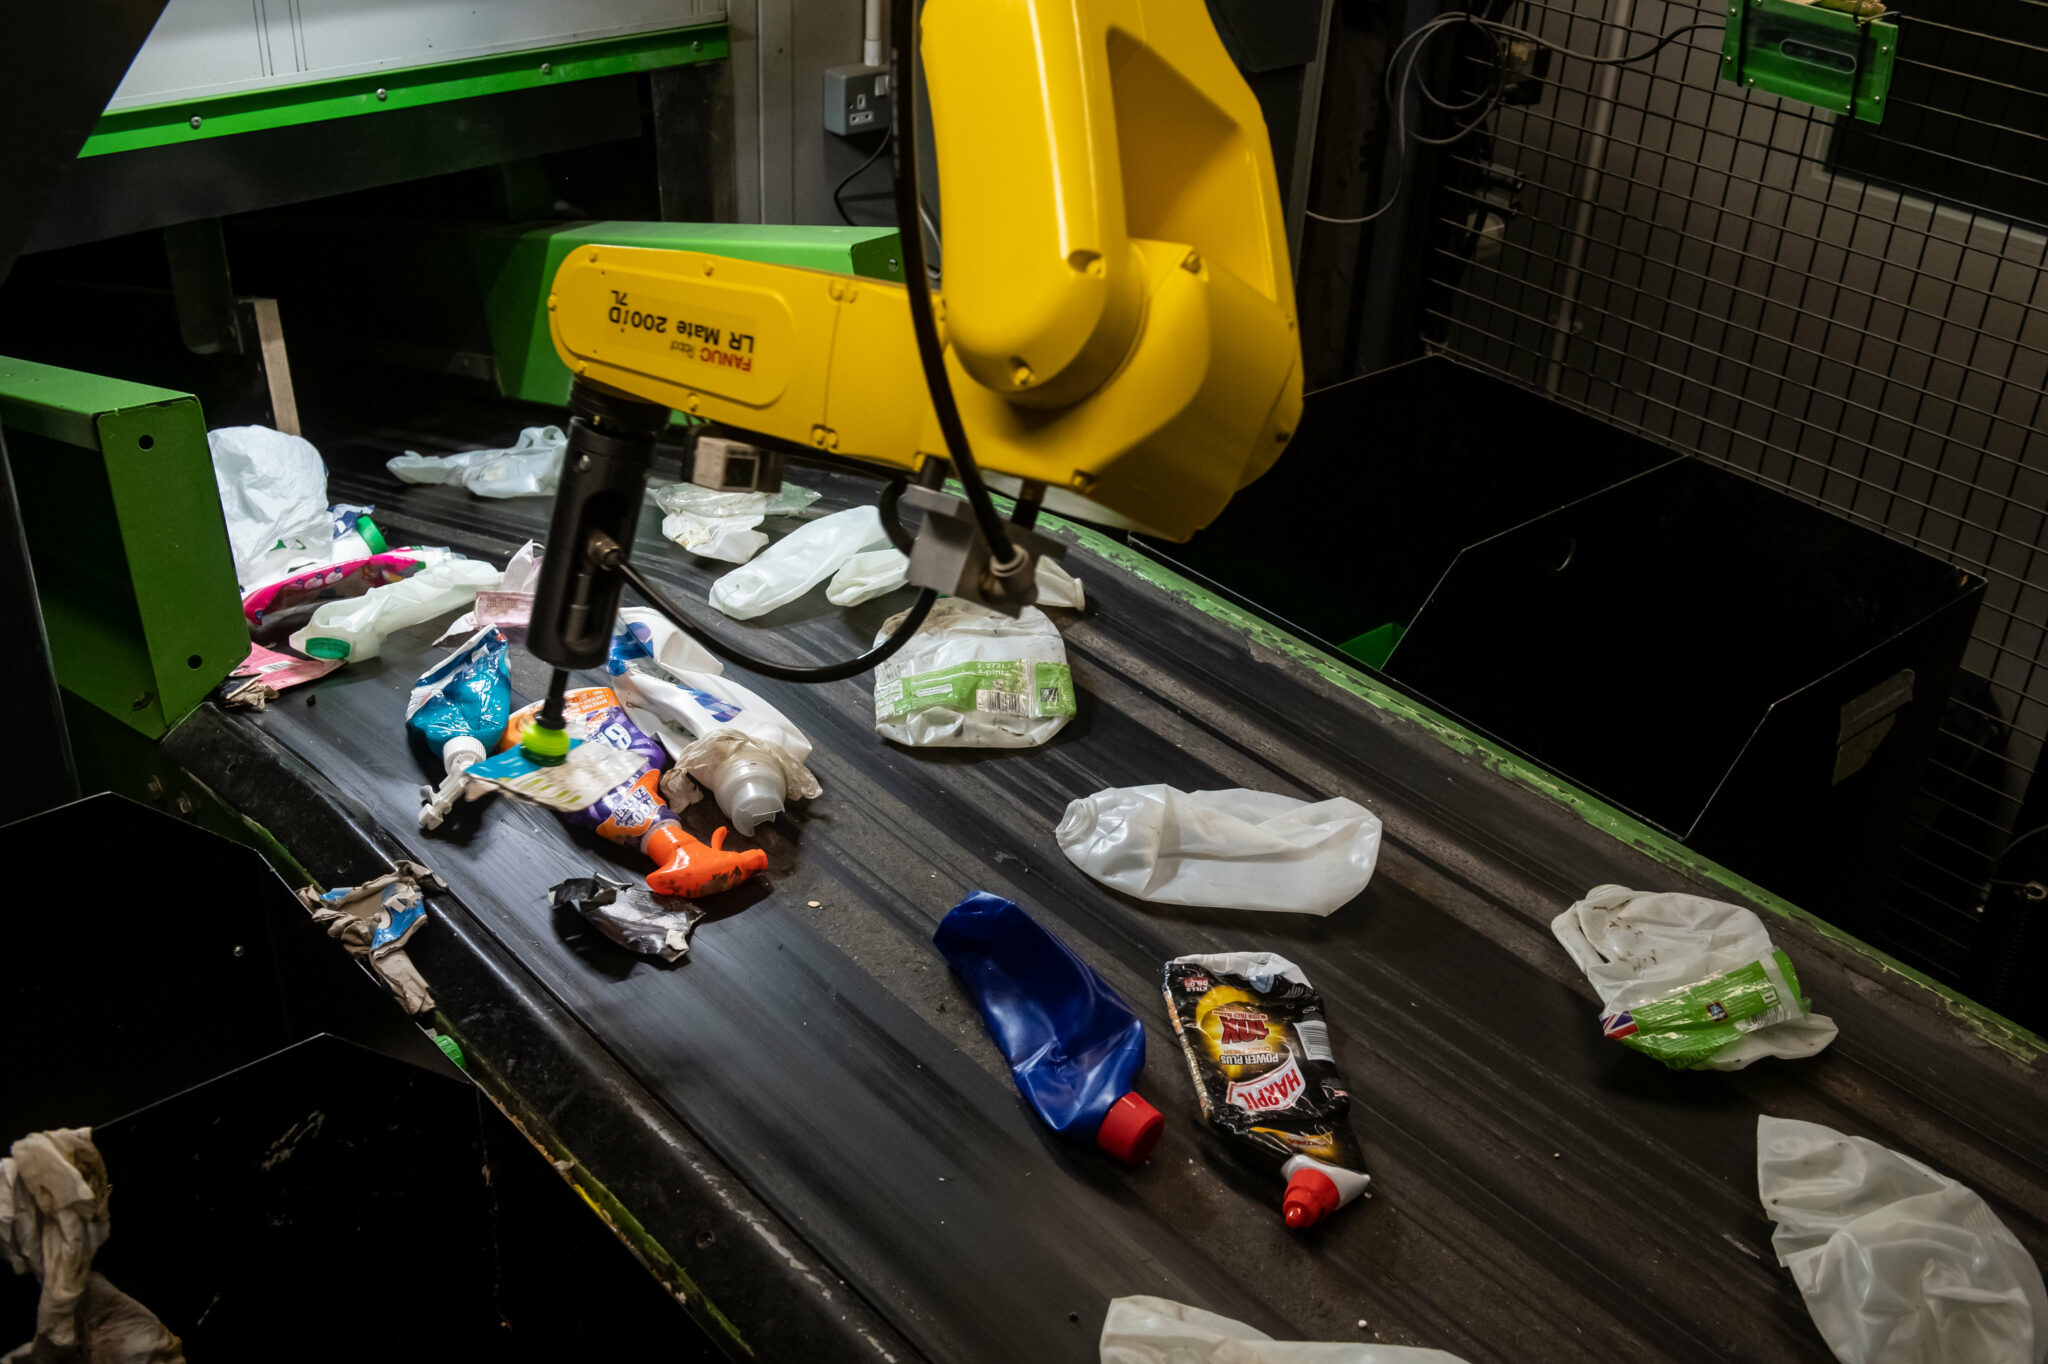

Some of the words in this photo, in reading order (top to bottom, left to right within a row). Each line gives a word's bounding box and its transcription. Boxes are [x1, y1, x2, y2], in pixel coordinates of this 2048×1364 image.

[610, 289, 629, 307] 7L
[677, 320, 720, 346] Mate
[729, 331, 754, 354] LR
[670, 340, 696, 359] Robot
[700, 347, 752, 372] FANUC
[1220, 1054, 1243, 1065] PLUS
[1244, 1052, 1279, 1065] POWER
